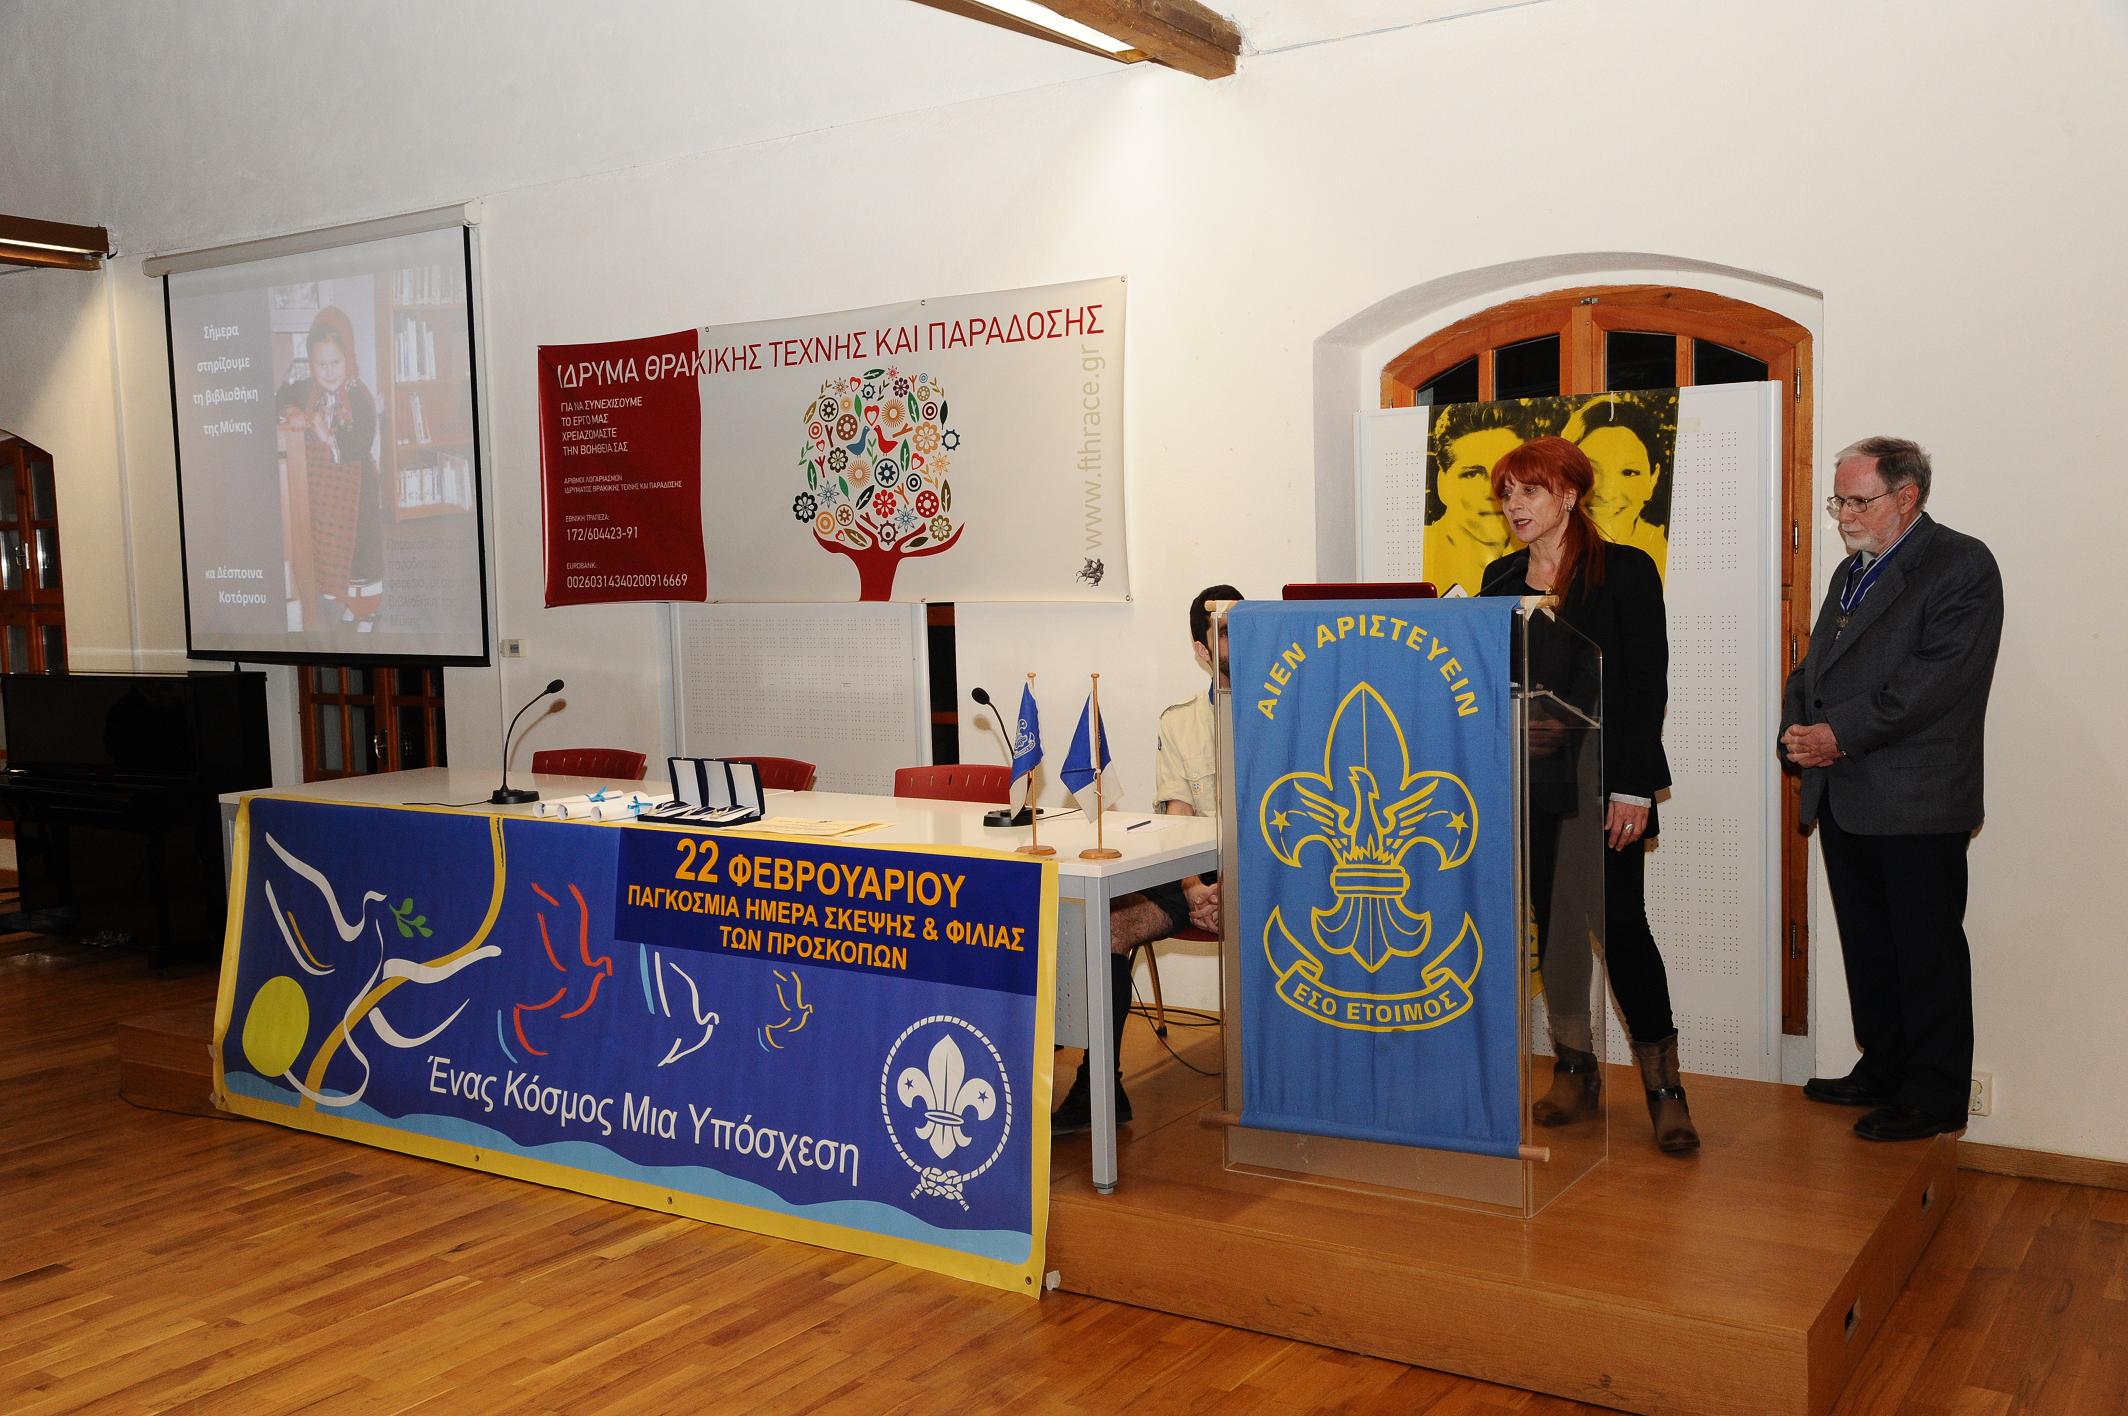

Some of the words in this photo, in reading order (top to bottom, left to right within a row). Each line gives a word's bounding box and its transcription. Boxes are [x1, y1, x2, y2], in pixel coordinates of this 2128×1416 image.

[203, 324, 240, 341] Σήμερα
[557, 357, 640, 389] ΙΔΡΥΜΑ
[644, 343, 763, 381] ΘΡΑΚΙΚΗΣ
[769, 331, 867, 367] ΤΕΧΝΗΣ
[875, 325, 919, 357] ΚΑΙ
[928, 304, 1105, 350] ΠΑΡΑΔΟΣΗΣ
[196, 356, 251, 374] στηρίζουμε
[192, 393, 204, 407] τη
[205, 386, 259, 406] βιβλιοθήκη
[560, 402, 574, 413] ΓΙΑ
[584, 396, 643, 410] ΣΥΝΕΧΙΣΟΥΜΕ
[202, 423, 219, 437] της
[219, 419, 253, 435] Μύκης
[561, 417, 572, 427] ΤΟ
[573, 415, 591, 426] ΕΡΓΟ
[591, 413, 609, 424] ΜΑΣ
[561, 427, 617, 442] ΧΡΕΙΑΖΟΜΑΣΤΕ
[562, 446, 579, 456] ΤΗΝ
[580, 443, 613, 455] ΒΟΗΘΕΙΑ
[613, 441, 629, 452] ΣΑΣ
[1077, 343, 1106, 551] www.fthrace.gr
[566, 526, 639, 541] 172/604423-91
[217, 564, 264, 579] Δέσποινα
[566, 573, 688, 588] 00260314340200916669
[219, 590, 267, 607] Κοτόρνου
[1257, 642, 1307, 720] ΑΙΕΝ
[1316, 614, 1479, 717] ΑΡΙΣΤΕΥΕΙΝ
[674, 837, 719, 884] 22
[728, 852, 966, 909] ΦΕΒΡΟΥΑΡΙΟΥ
[627, 884, 740, 918] ΠΑΓΚΟΣΜΙΑ
[745, 899, 819, 928] ΗΜΕΡΑ
[824, 906, 916, 939] ΣΚΕΨΗΣ
[922, 918, 939, 941] &
[946, 919, 1025, 953] ΦΙΛΙΑΣ
[719, 925, 761, 951] ΤΩΝ
[767, 931, 908, 971] ΠΡΟΣΚΟΠΩΝ
[1293, 982, 1337, 1015] ΕΣΟ
[1346, 990, 1458, 1022] ΕΤΟΙΜΟΣ
[427, 1054, 497, 1112] Ένας
[504, 1069, 614, 1136] Κόσμος
[622, 1091, 677, 1140] Μια
[688, 1102, 859, 1187] Υπόσχεση
